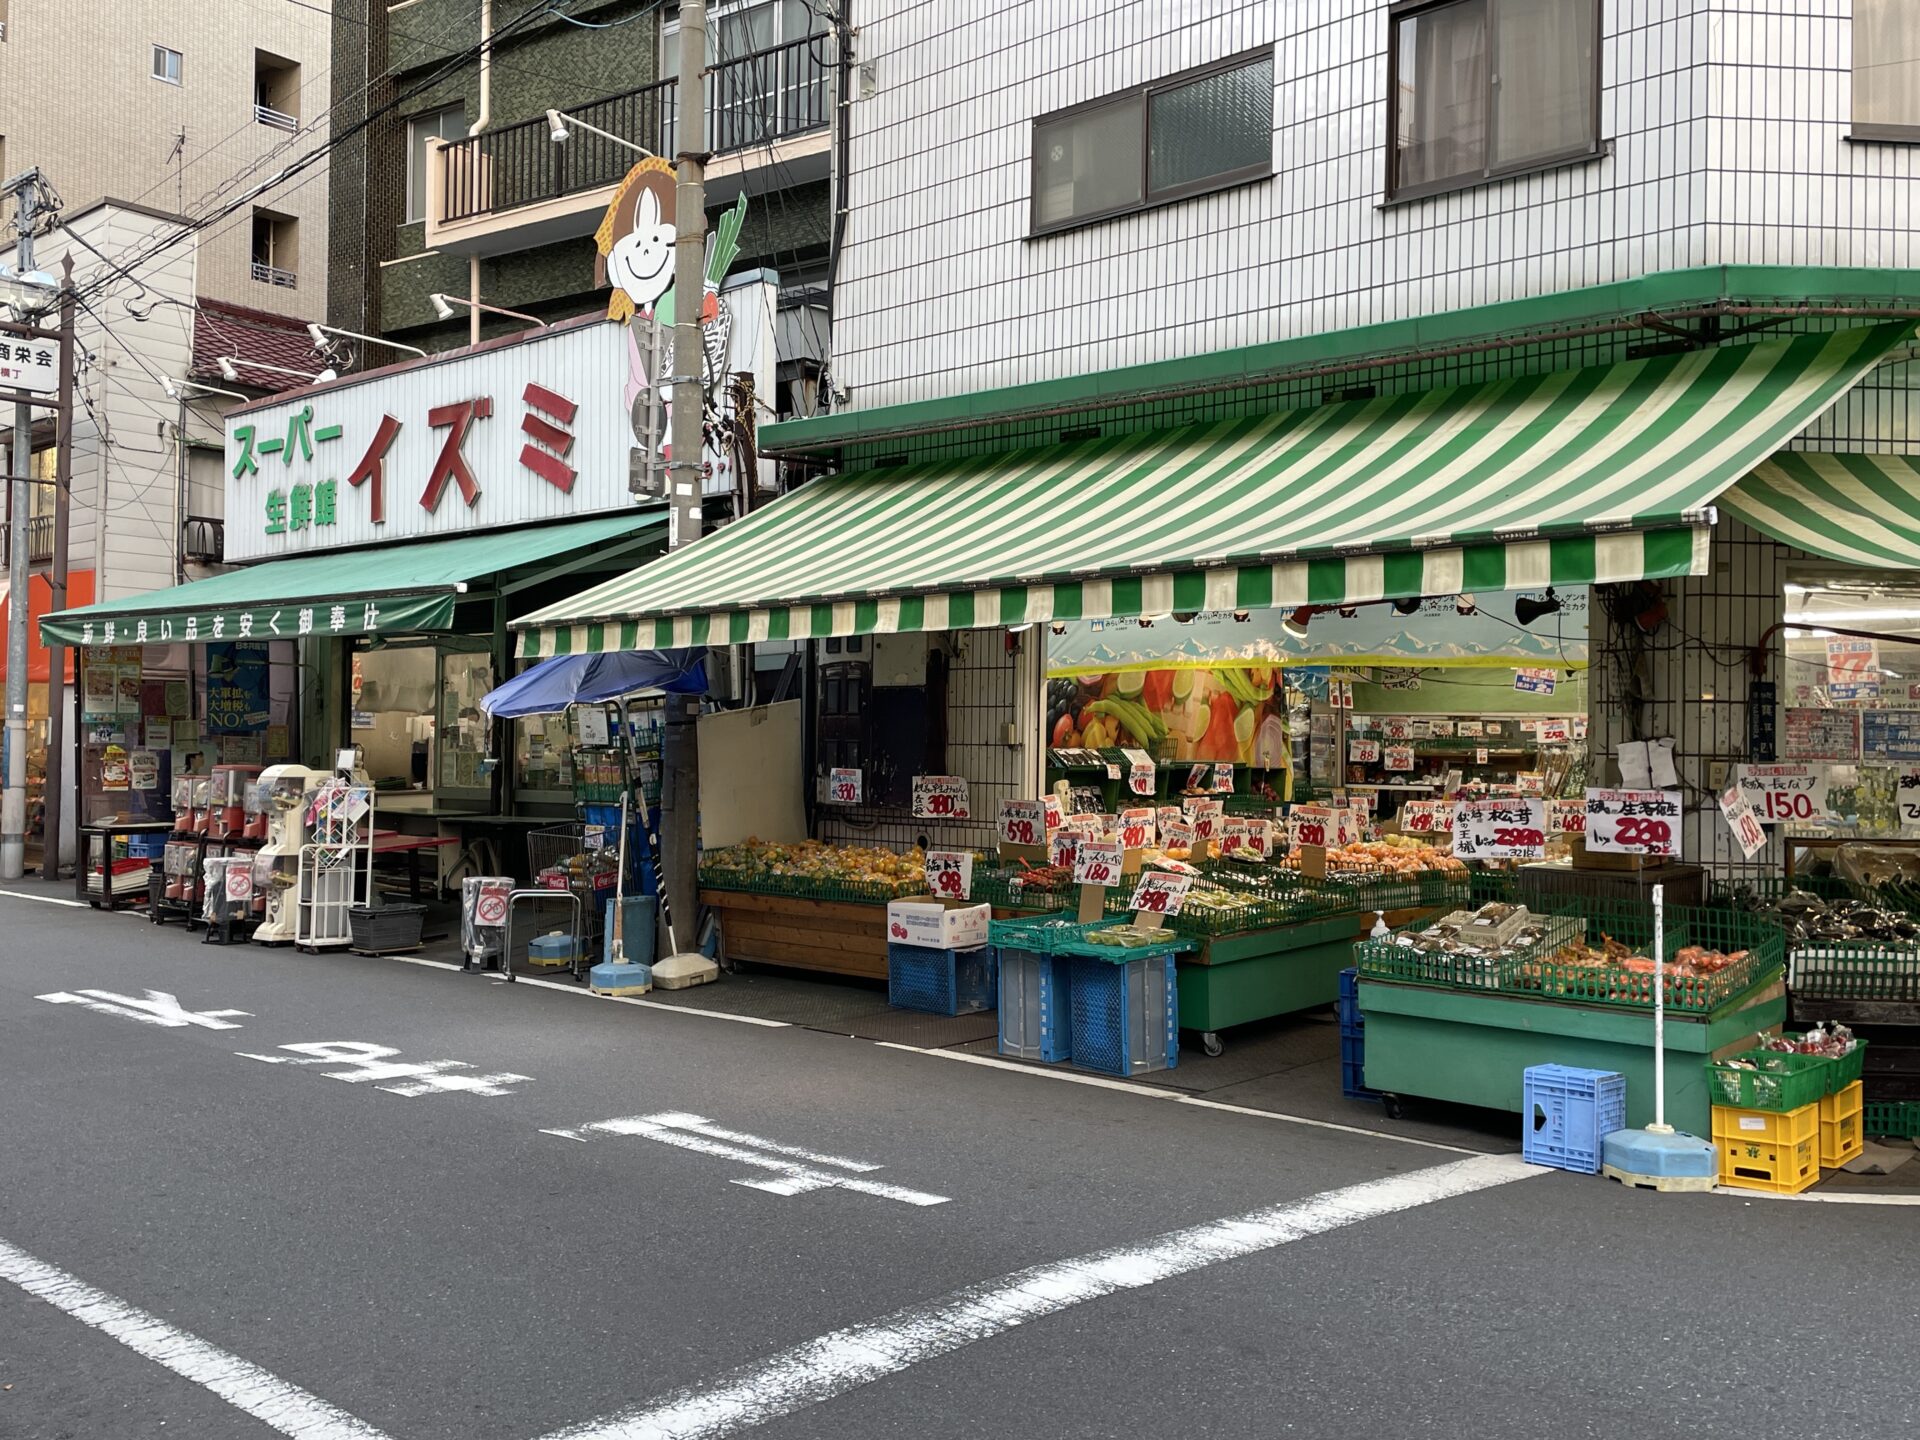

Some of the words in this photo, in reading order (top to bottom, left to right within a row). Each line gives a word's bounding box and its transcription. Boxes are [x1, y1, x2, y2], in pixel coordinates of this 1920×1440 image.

[232, 405, 342, 479] スーパー
[347, 382, 578, 524] イズミ
[264, 480, 338, 534] 生鮮館
[208, 712, 244, 728] NO!
[1360, 750, 1374, 761] 88
[1768, 775, 1819, 792] 長なす
[926, 793, 955, 815] 380
[1765, 791, 1814, 819] 150
[1410, 813, 1434, 831] 498
[1486, 806, 1533, 826] 松茸
[1562, 814, 1586, 833] 480
[1007, 819, 1034, 844] 598
[1493, 827, 1545, 848] 2980
[1614, 817, 1672, 846] 280
[938, 870, 962, 893] 98
[1084, 862, 1110, 881] 180
